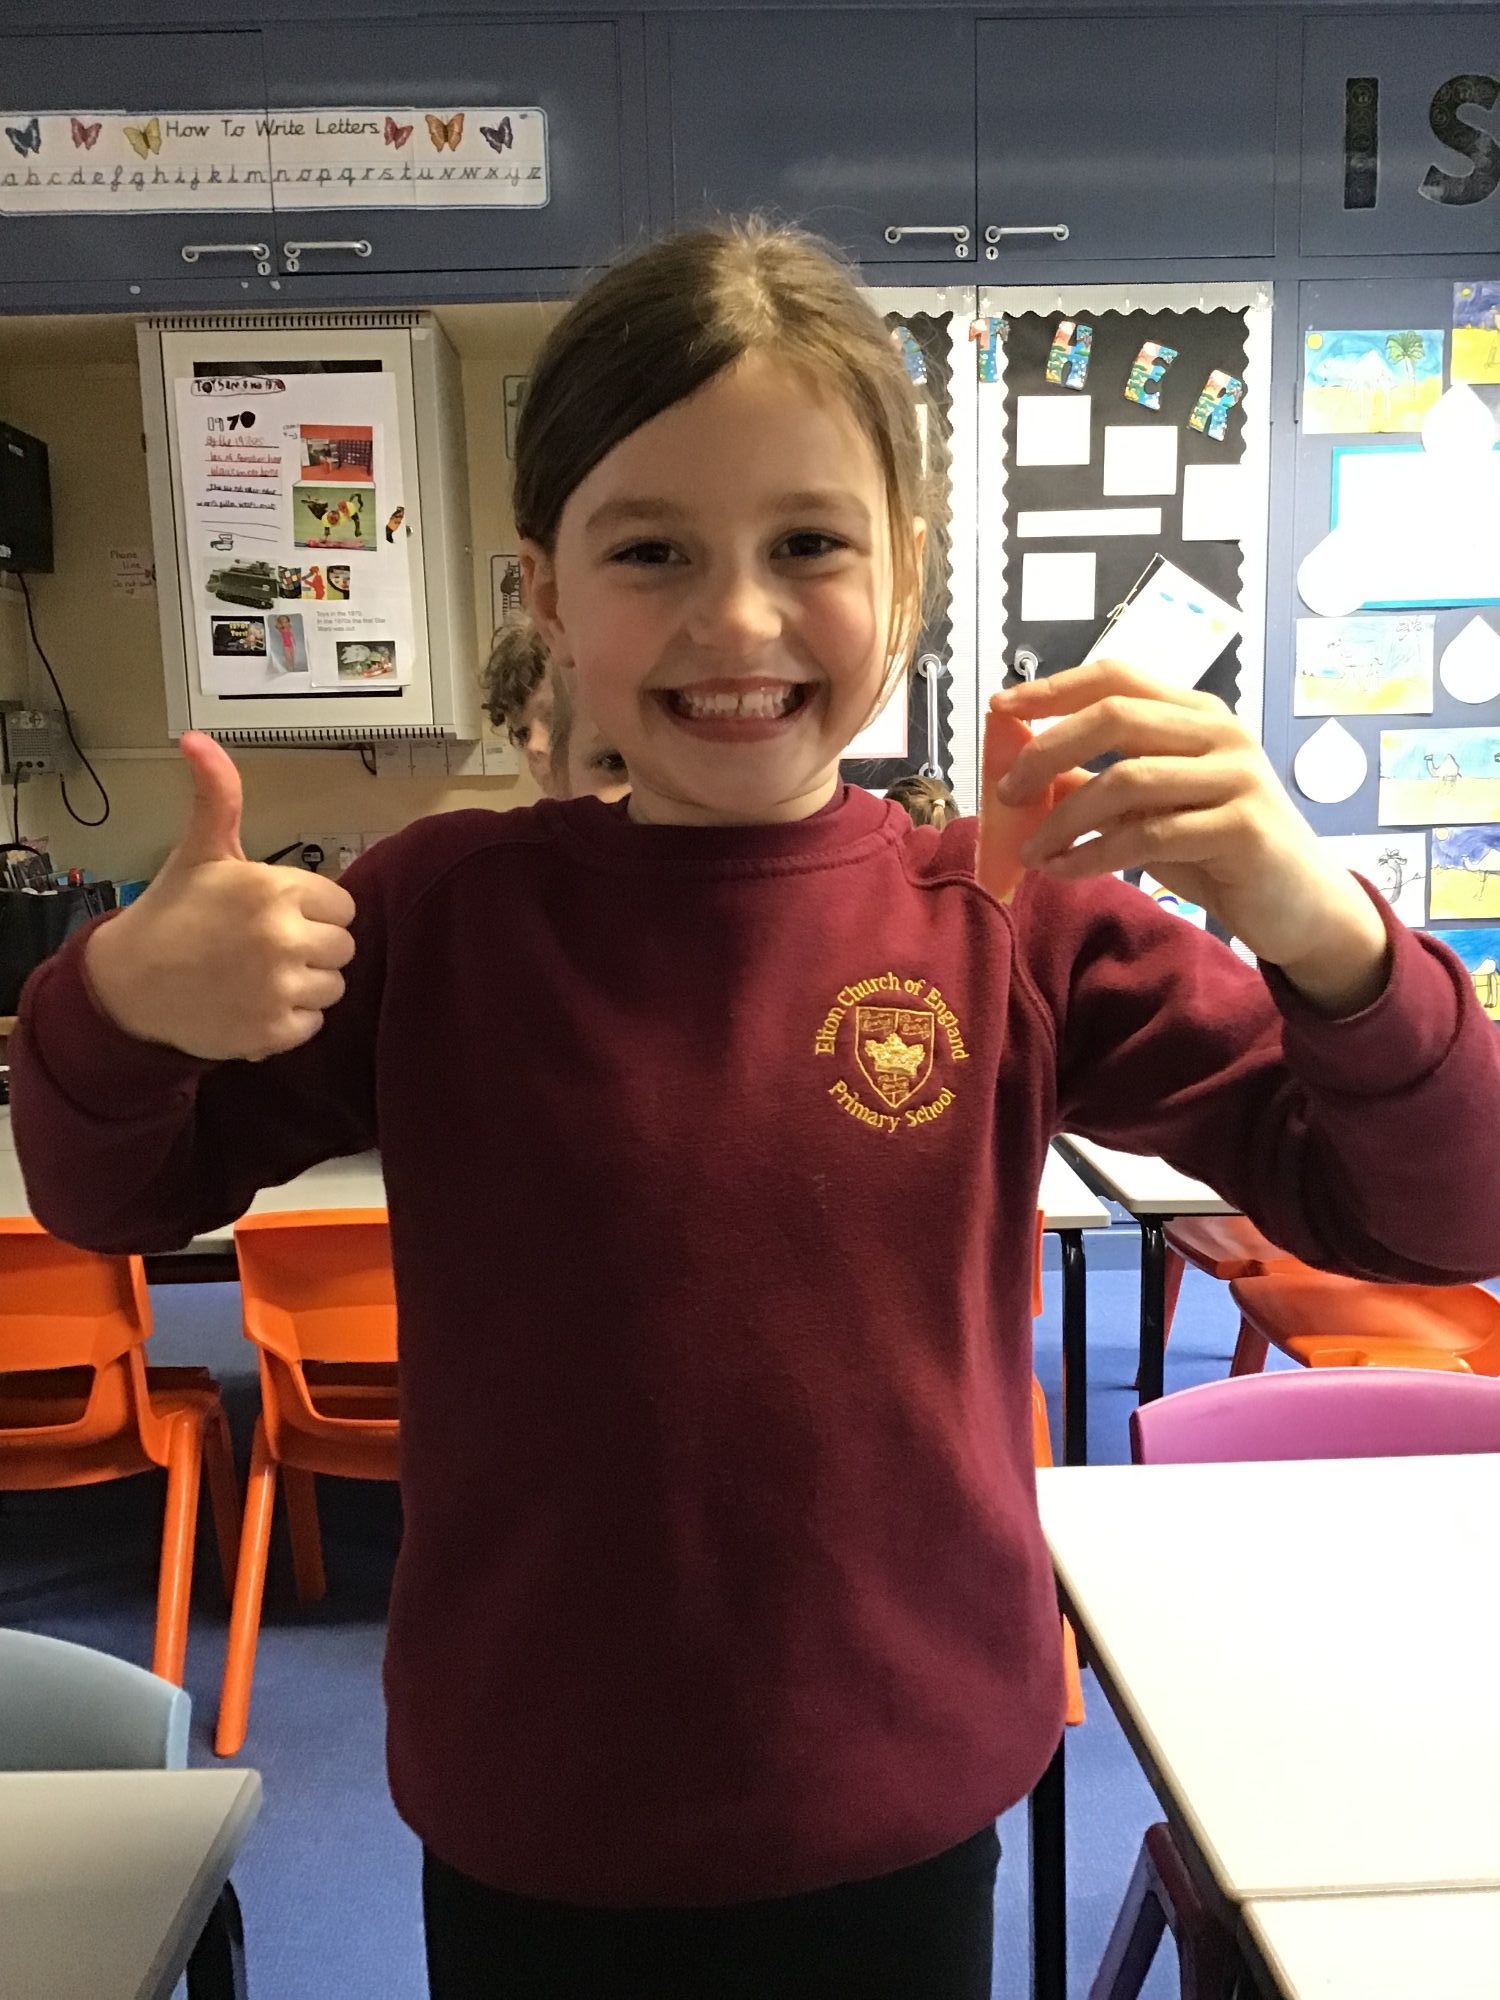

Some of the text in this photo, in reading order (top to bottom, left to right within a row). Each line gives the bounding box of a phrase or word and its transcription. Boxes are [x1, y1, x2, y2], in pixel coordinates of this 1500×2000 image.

[166, 117, 380, 137] How To Write Letters
[207, 411, 256, 432] 1970
[837, 972, 901, 1006] Church
[904, 978, 927, 996] of
[923, 987, 970, 1063] England
[828, 1080, 957, 1133] Primary School
